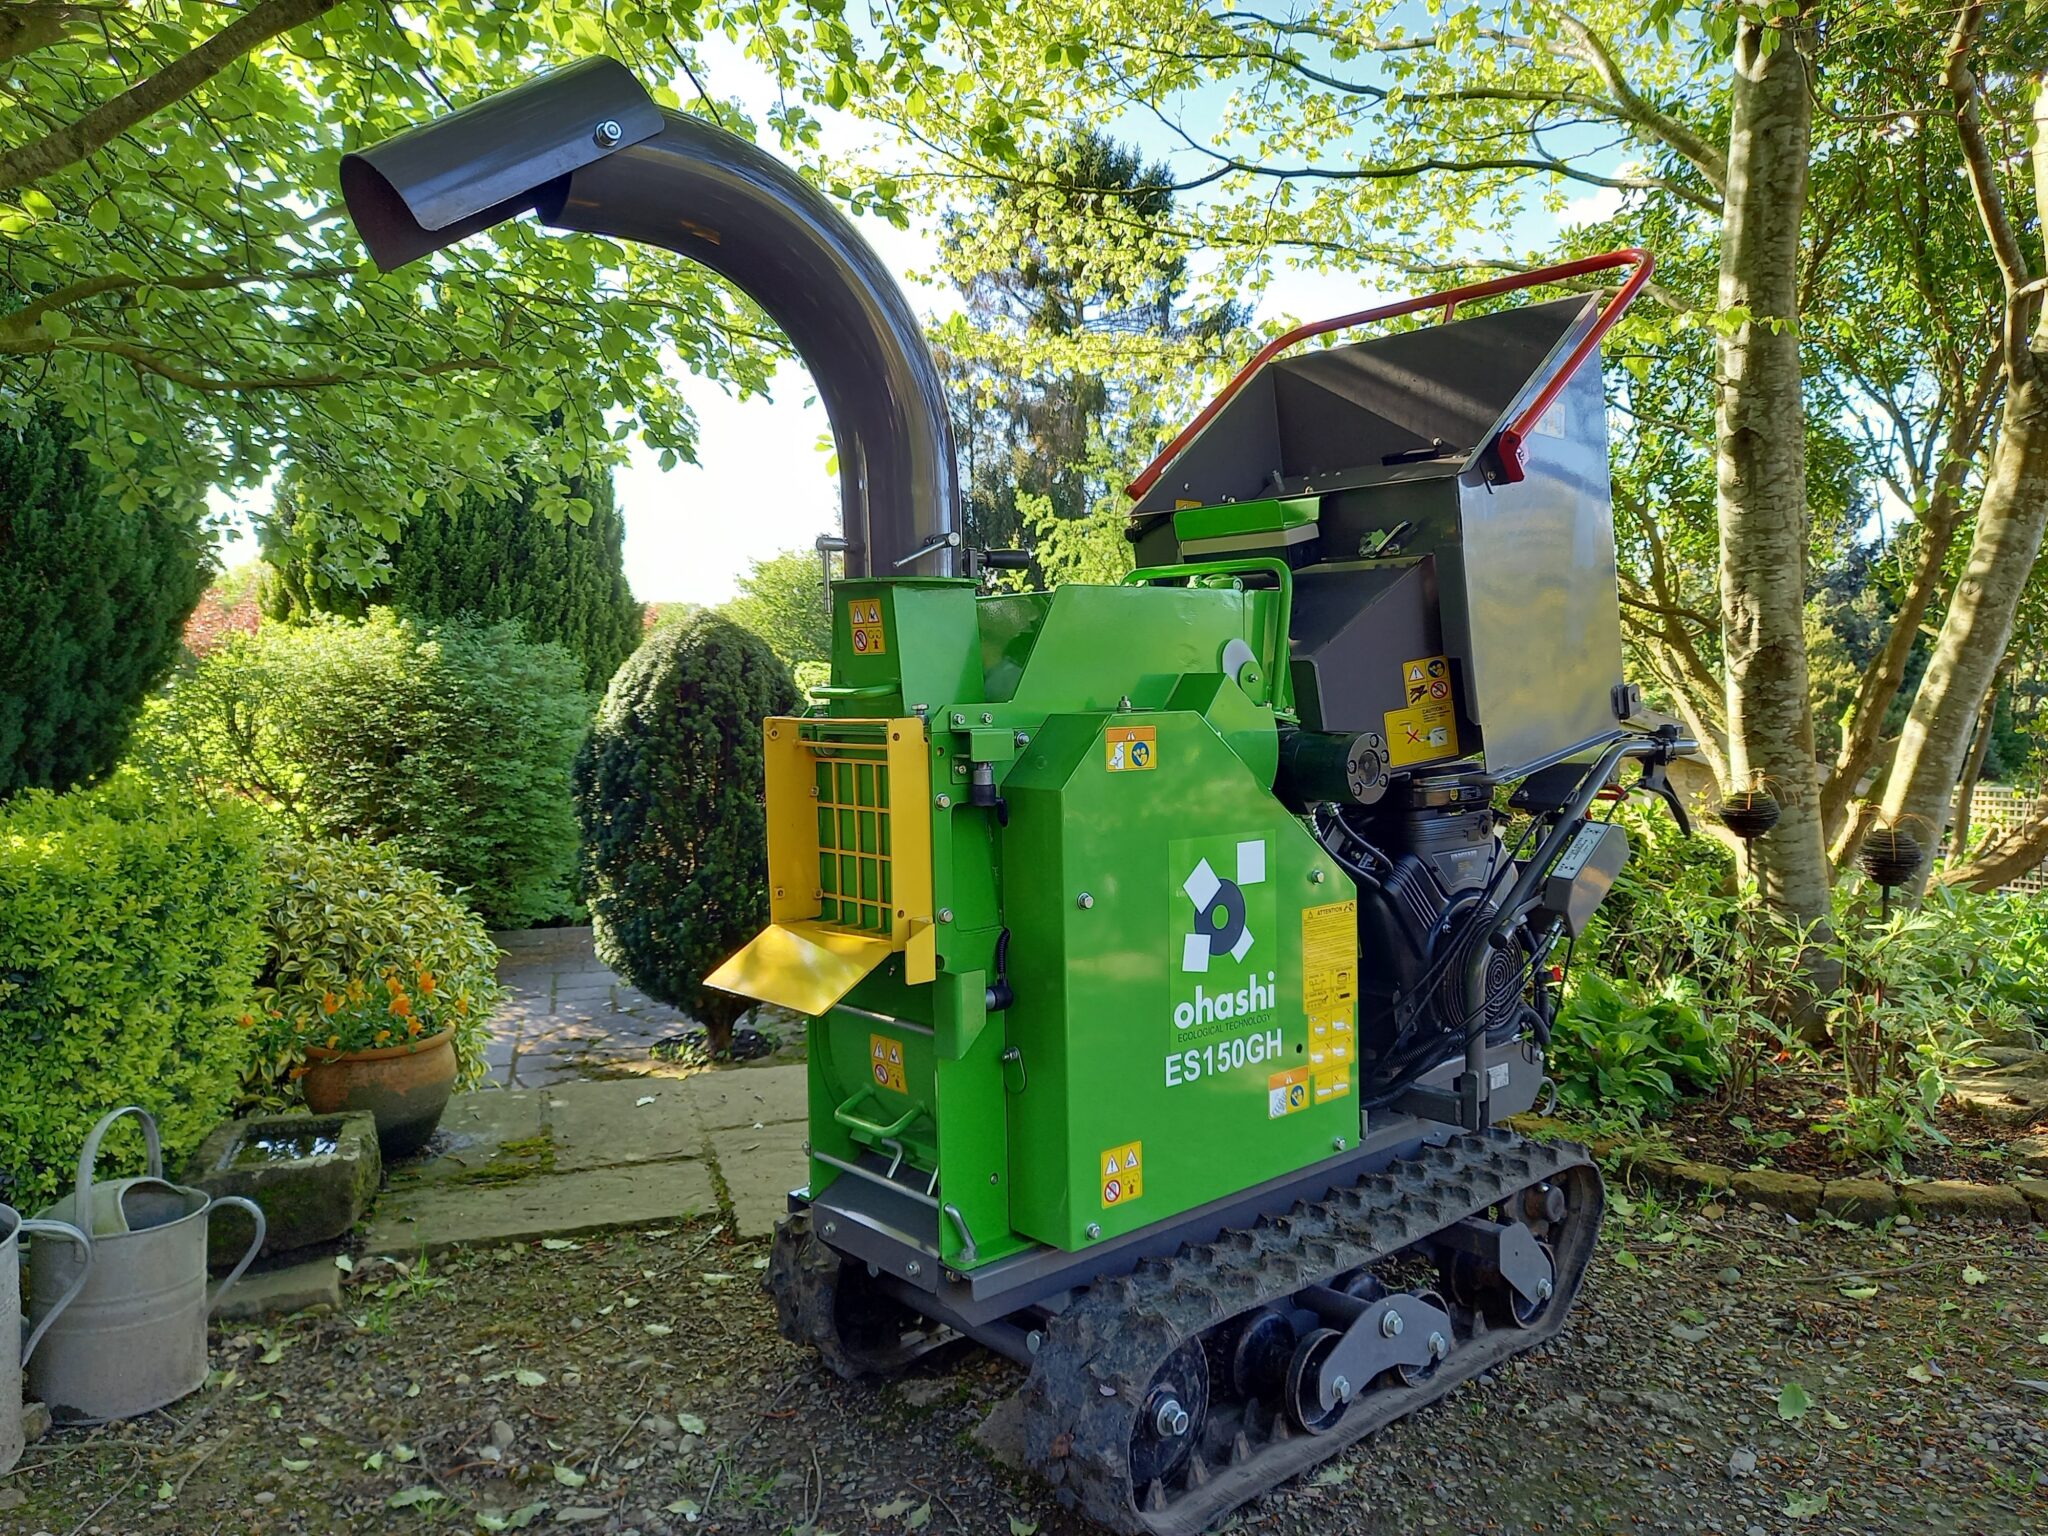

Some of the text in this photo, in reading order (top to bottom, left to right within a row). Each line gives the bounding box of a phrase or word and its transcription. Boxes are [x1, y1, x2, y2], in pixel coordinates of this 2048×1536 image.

[1317, 906, 1342, 916] ATTENTION
[1174, 971, 1275, 1029] ohashi
[1177, 1013, 1271, 1043] ECOLOGICAL TECHNOLOGY
[1165, 1028, 1282, 1087] ES150GH
